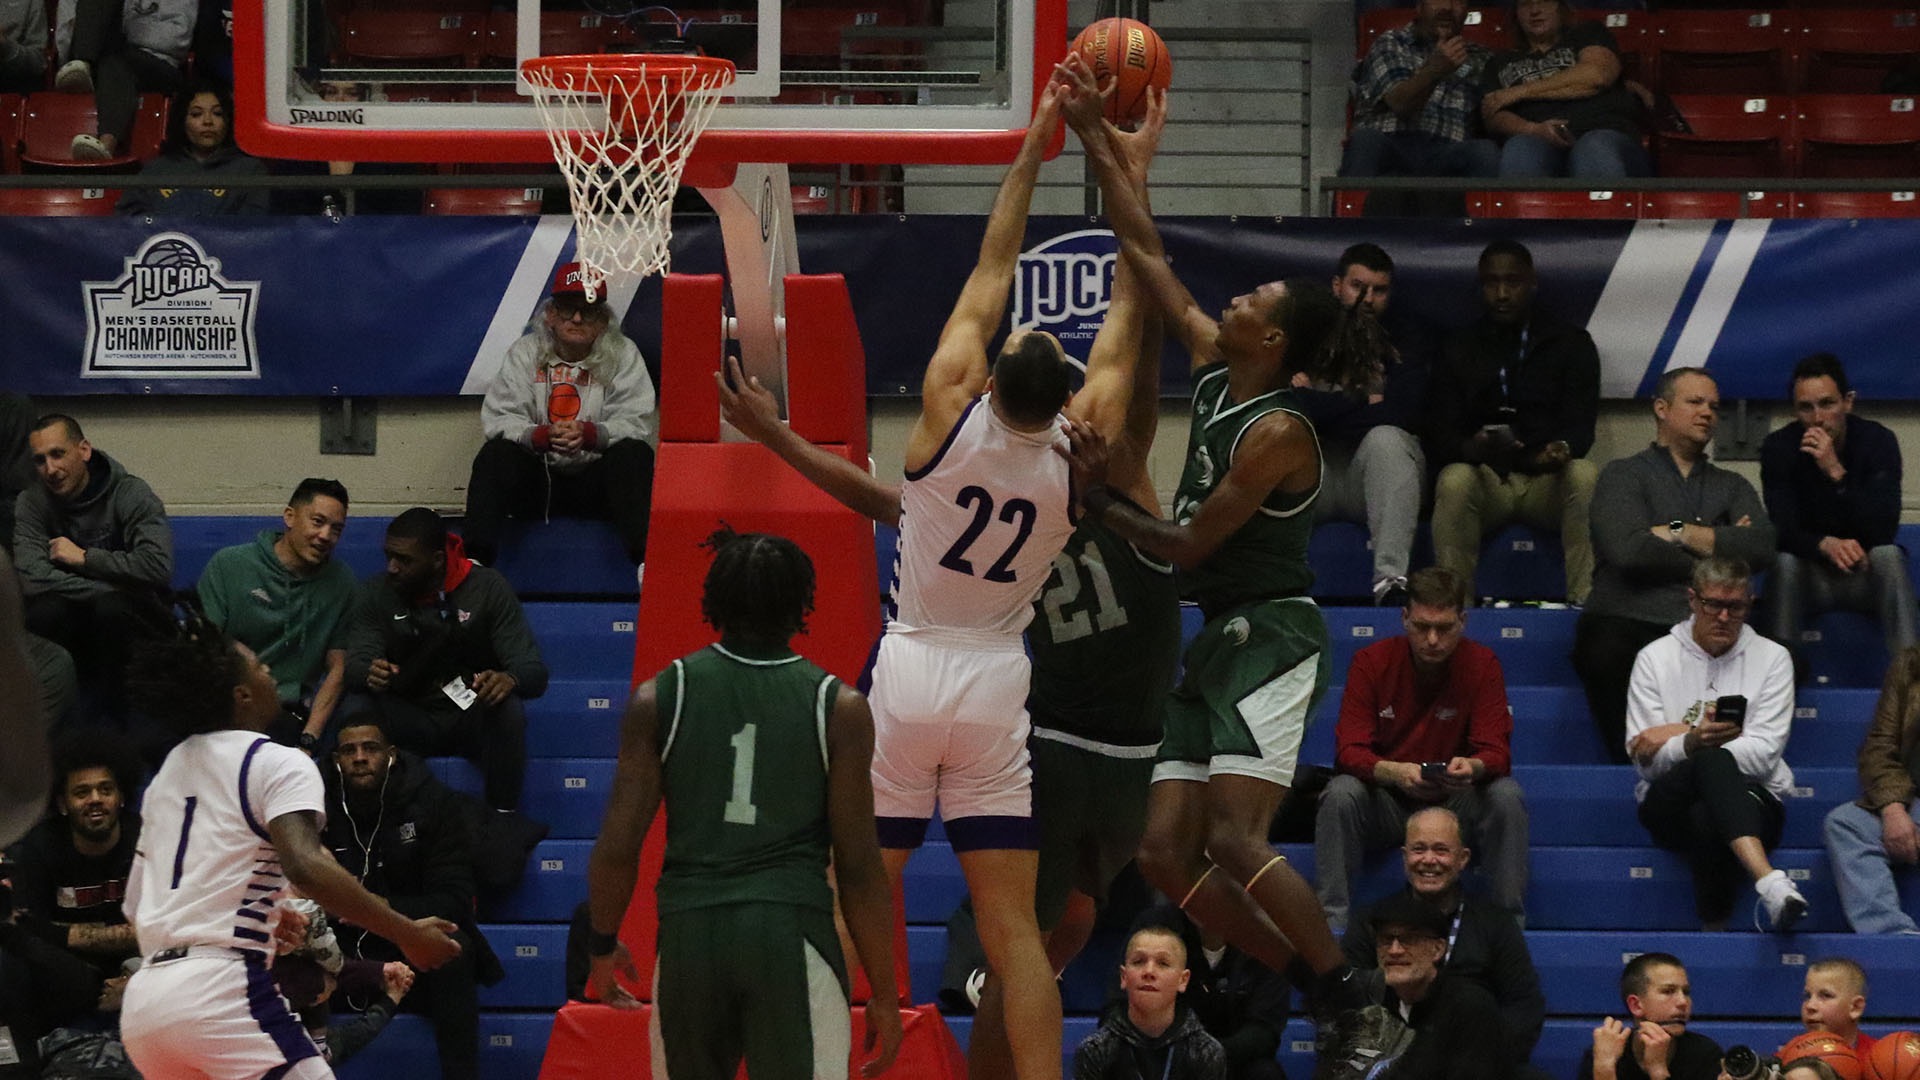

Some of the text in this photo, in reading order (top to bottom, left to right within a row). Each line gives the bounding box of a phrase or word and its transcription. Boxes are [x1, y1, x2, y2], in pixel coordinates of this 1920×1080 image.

[290, 108, 365, 125] SPALDING
[132, 265, 210, 307] NJCAA
[1018, 259, 1117, 326] NJC
[105, 316, 237, 326] MEN'S BASKETBALL
[105, 327, 237, 351] CHAMPIONSHIP
[939, 485, 1037, 583] 22
[1038, 540, 1129, 644] 21
[723, 723, 757, 825] 1
[171, 796, 197, 889] 1
